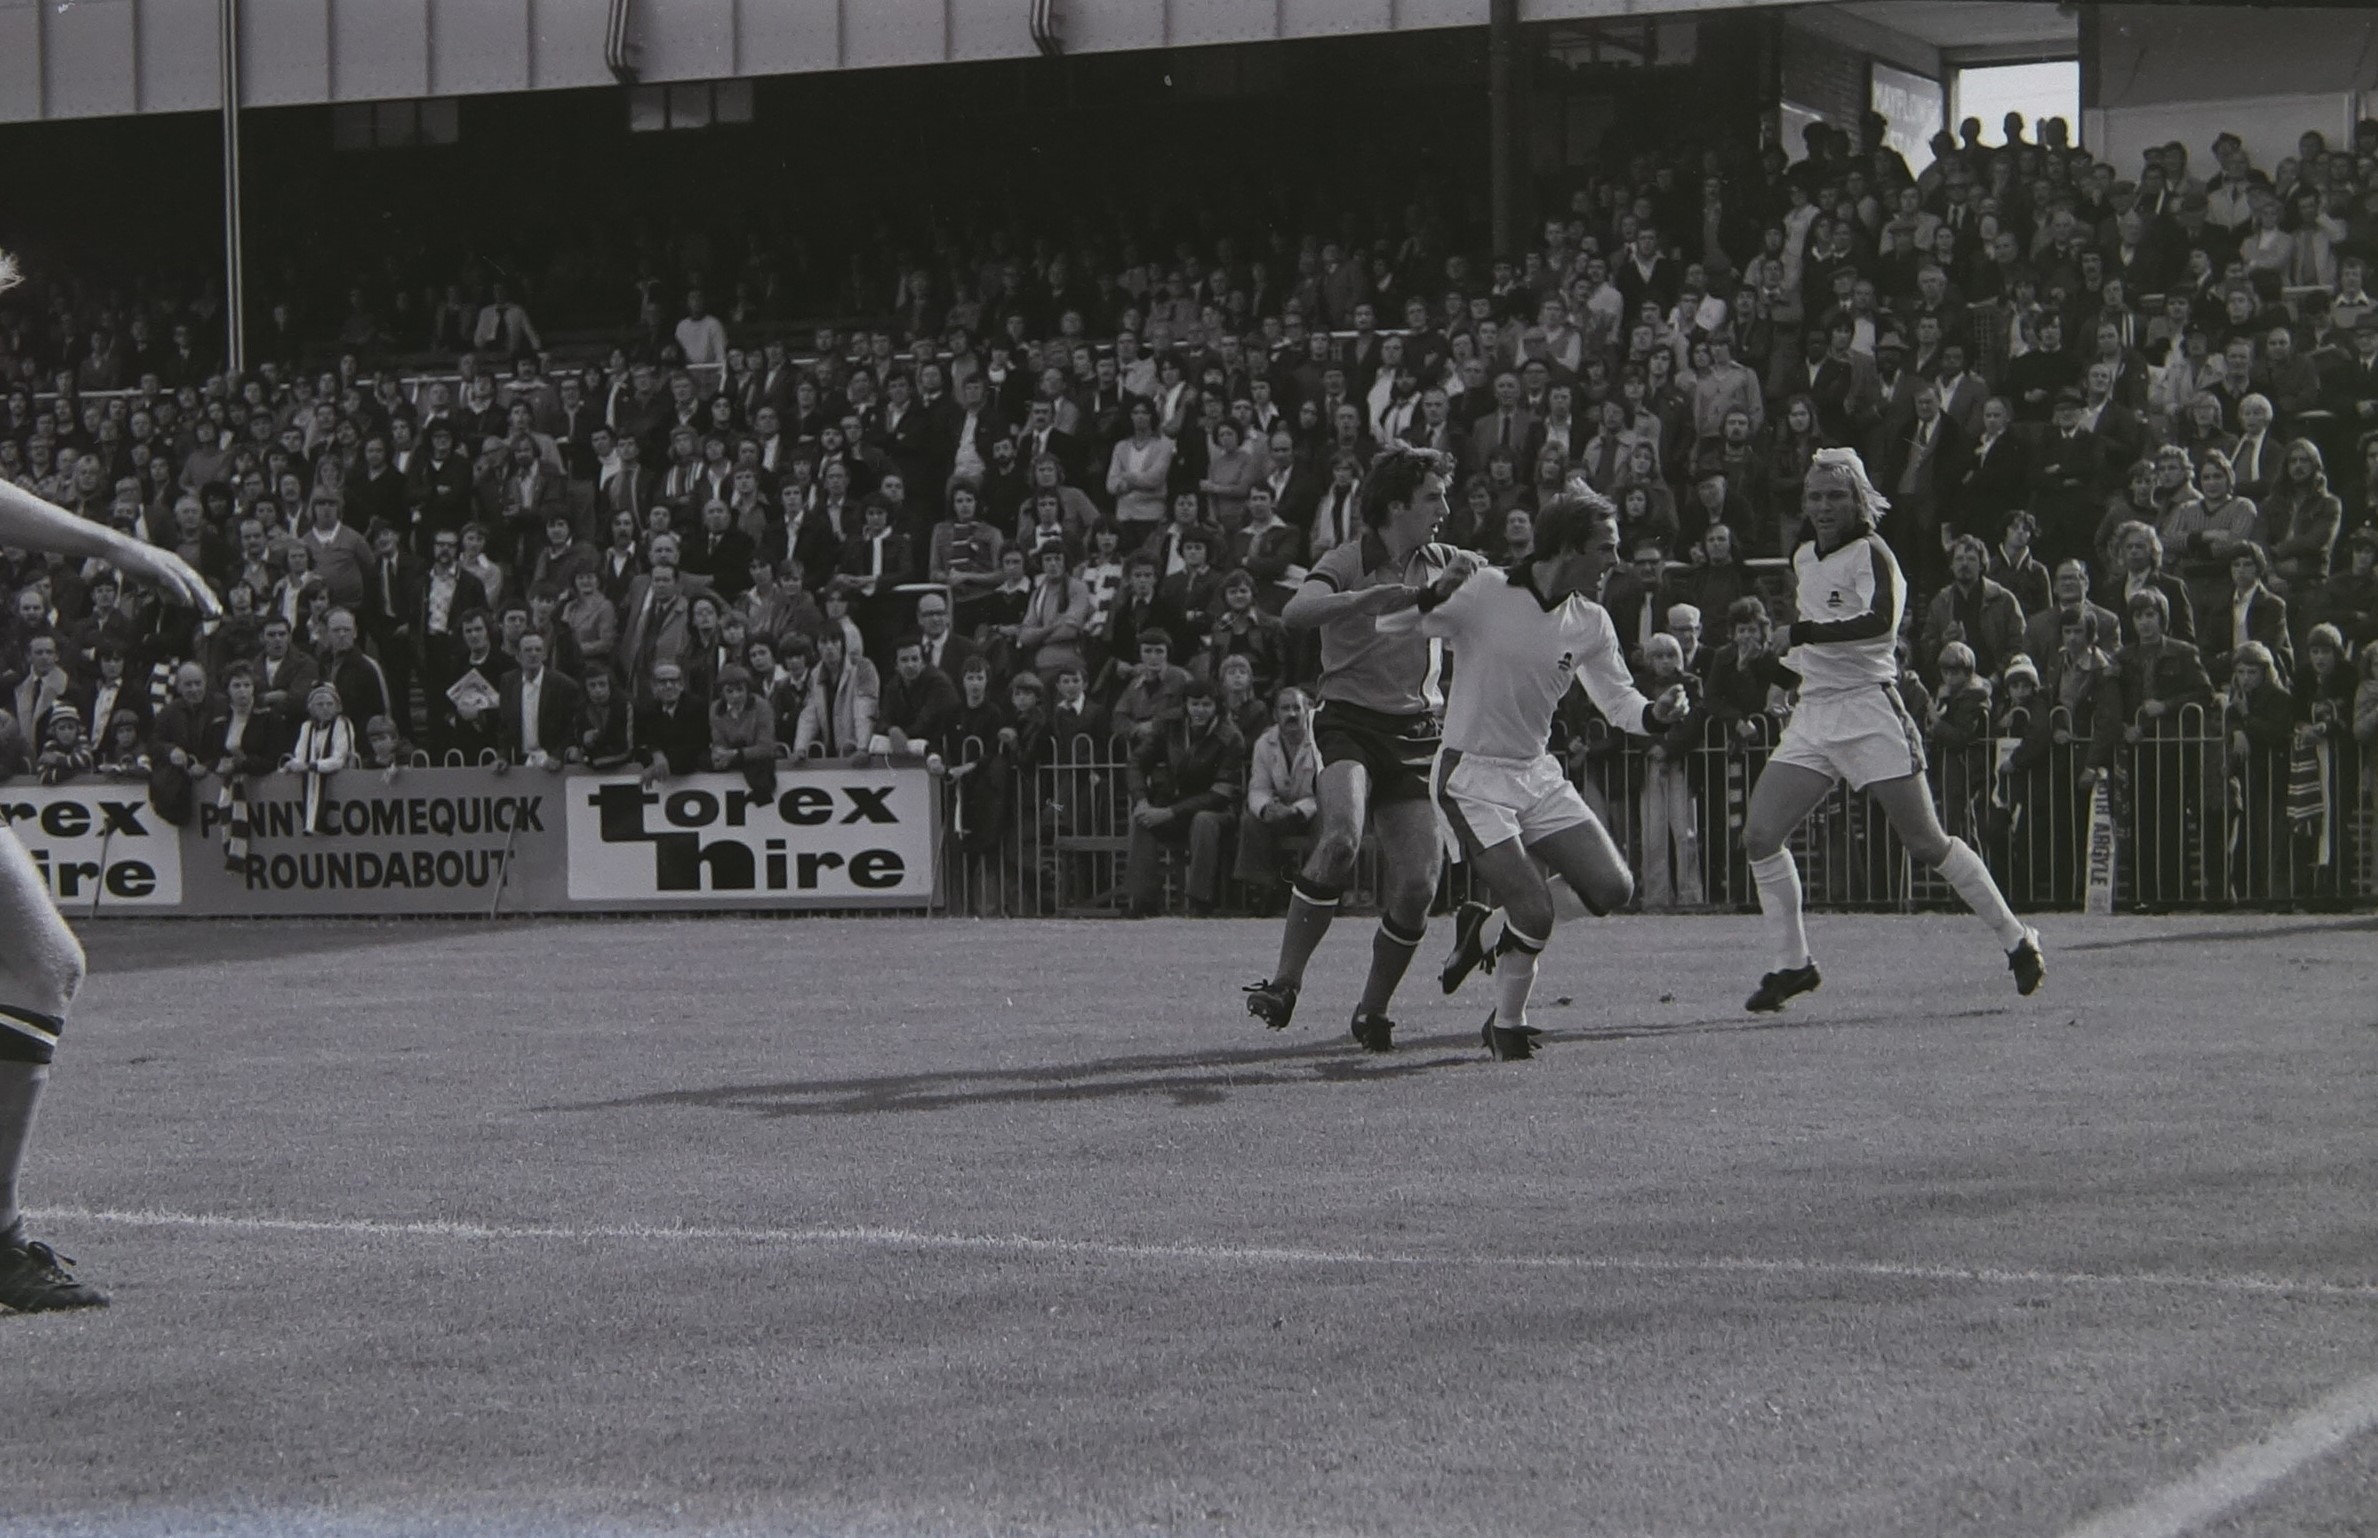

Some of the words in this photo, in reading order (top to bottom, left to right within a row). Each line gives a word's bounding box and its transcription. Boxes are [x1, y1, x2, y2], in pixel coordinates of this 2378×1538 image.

[200, 795, 544, 838] PNNCOMEQUICK
[588, 784, 900, 843] torex
[246, 849, 515, 890] ROUNDABOUT
[657, 832, 906, 891] hire
[2091, 822, 2111, 887] ARGYLE
